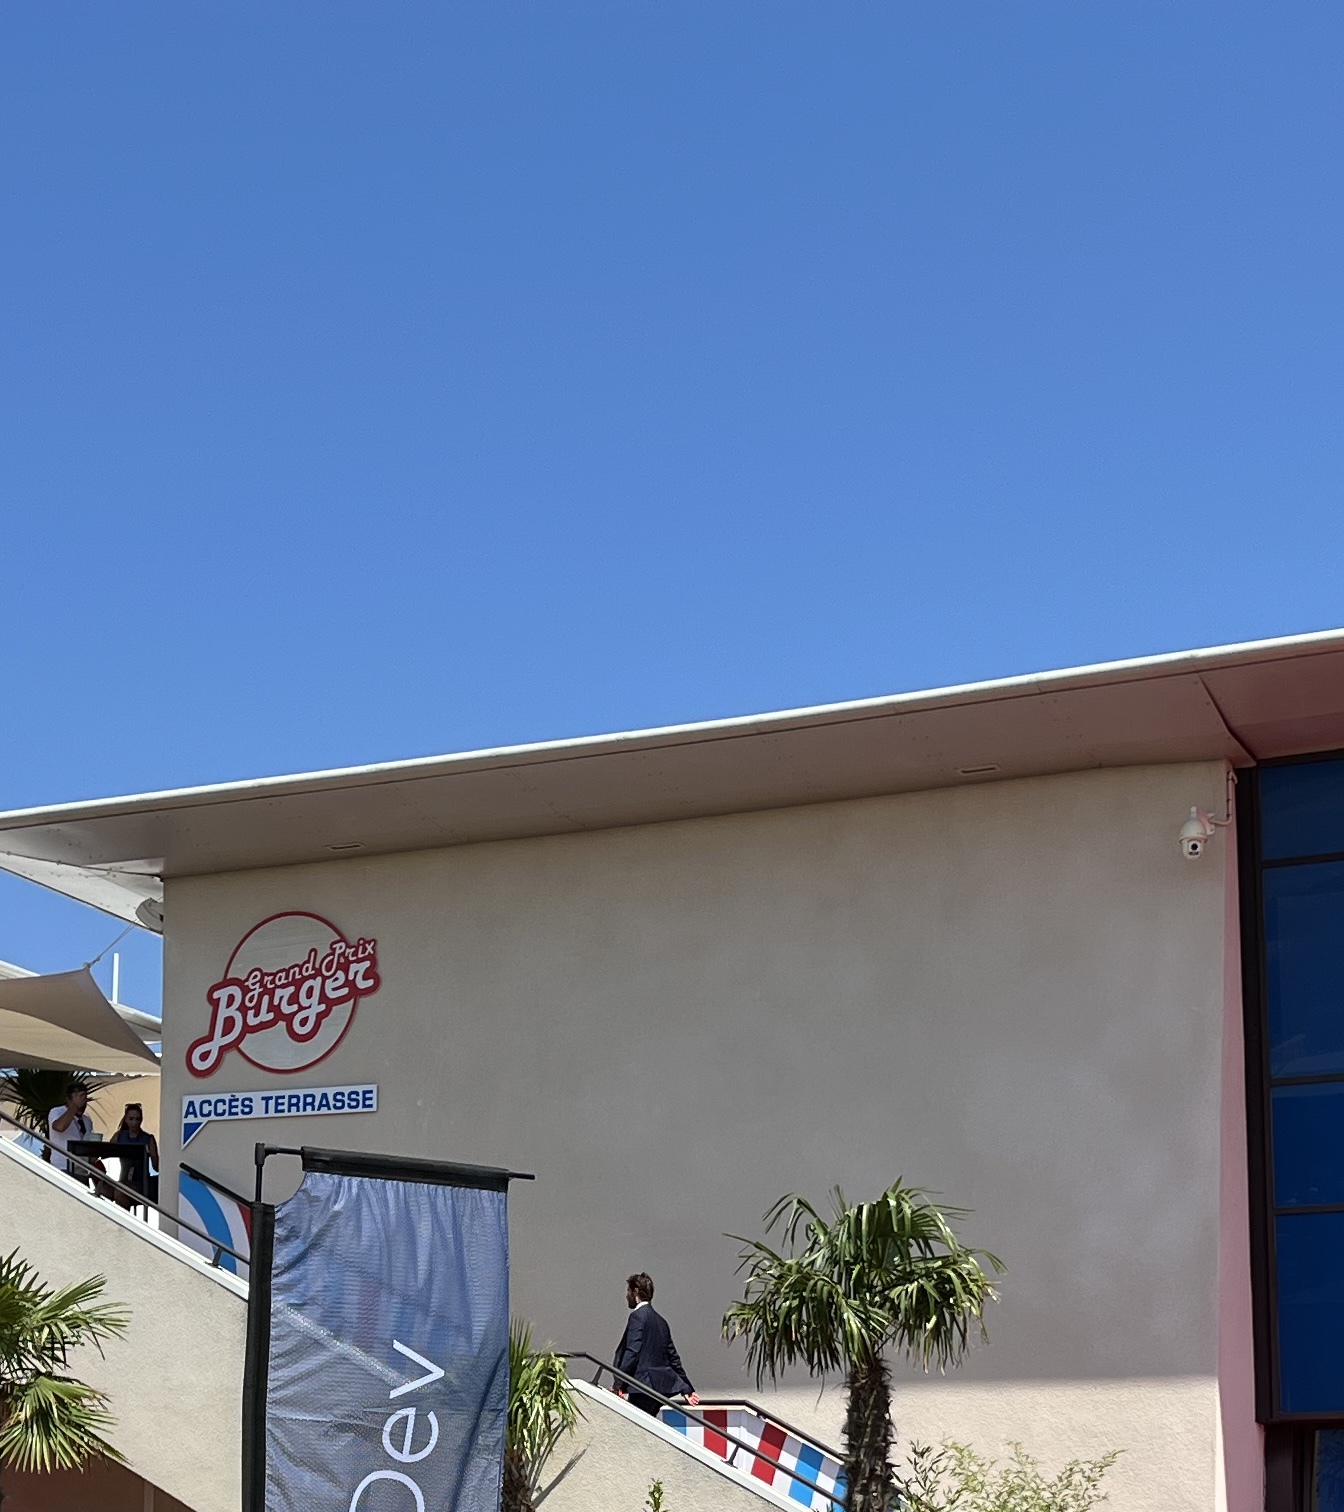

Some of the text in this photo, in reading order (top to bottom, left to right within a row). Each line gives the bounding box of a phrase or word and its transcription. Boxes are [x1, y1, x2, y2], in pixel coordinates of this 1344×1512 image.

[244, 938, 376, 1007] Grand Prix
[191, 960, 376, 1071] Burger
[183, 1089, 374, 1119] ACCÈS TERRASSE
